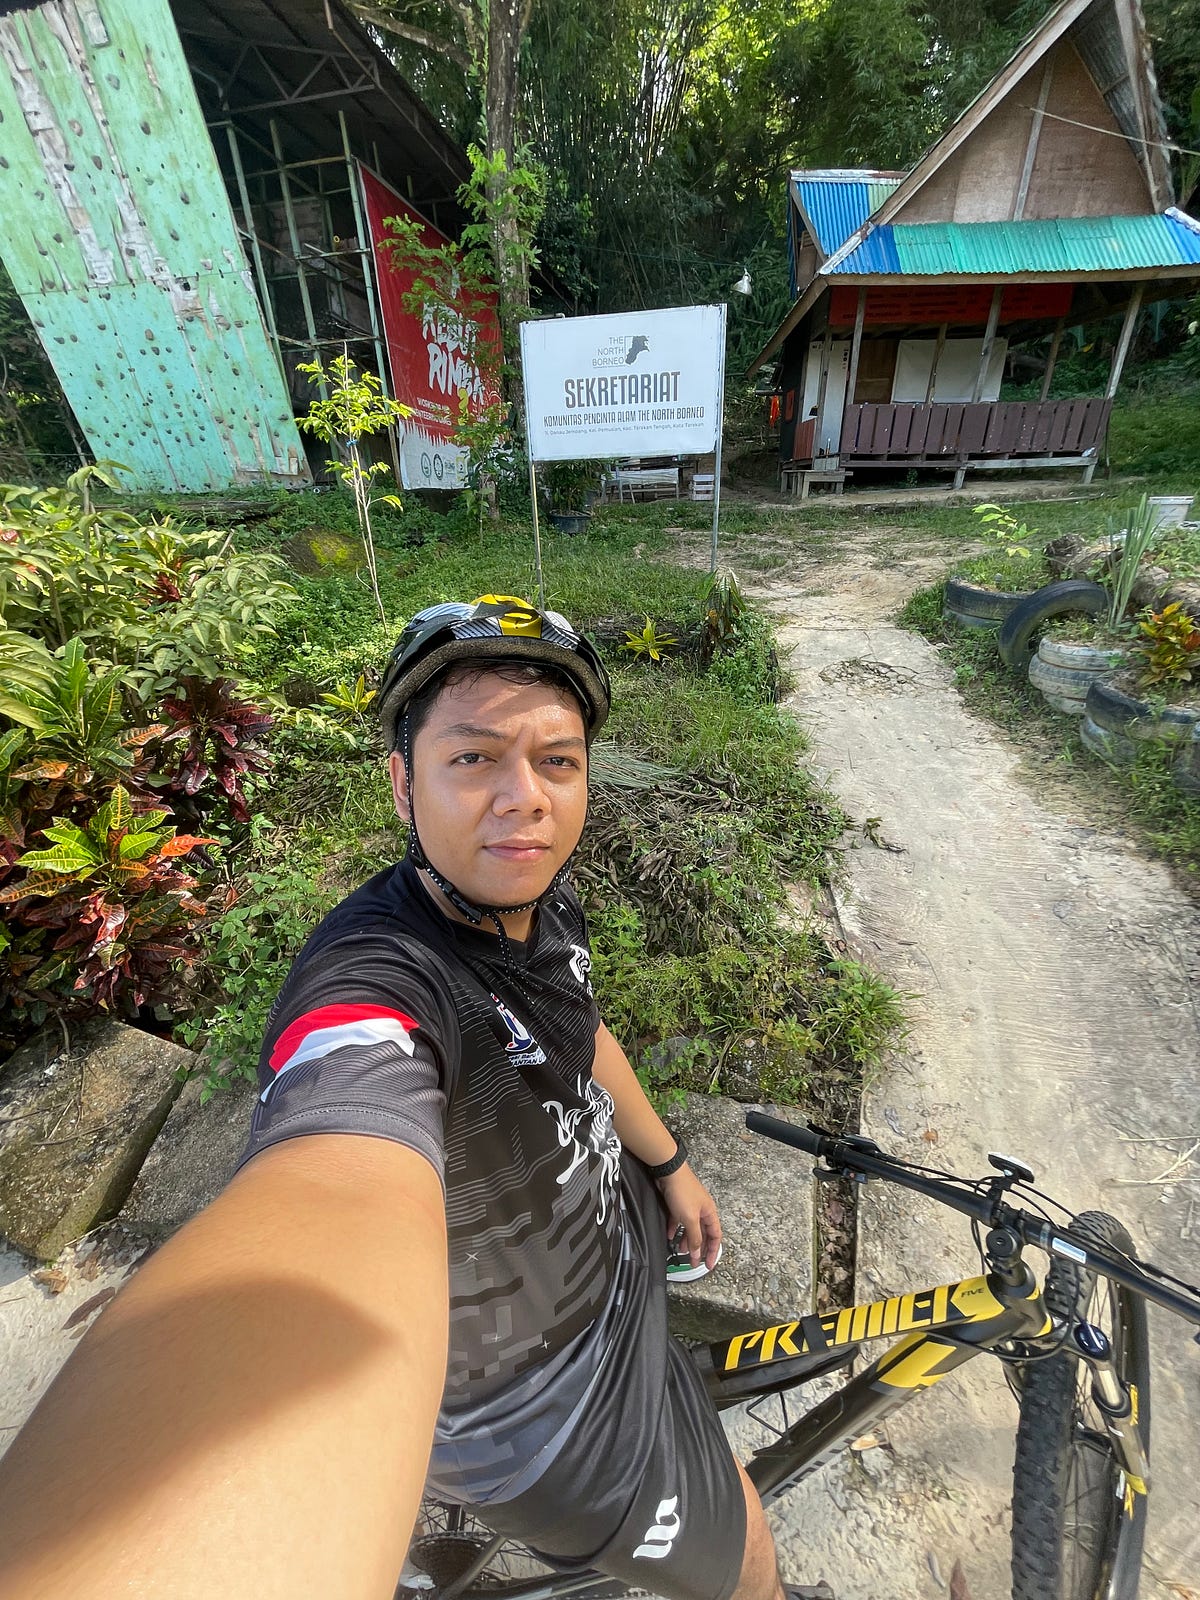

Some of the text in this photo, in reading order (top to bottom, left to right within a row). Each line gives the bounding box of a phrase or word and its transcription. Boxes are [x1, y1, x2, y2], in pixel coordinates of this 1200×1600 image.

[609, 336, 624, 345] THE
[597, 347, 624, 356] NORTH
[592, 356, 625, 366] BORNEO
[564, 371, 681, 408] SEKRETARIAT
[543, 406, 705, 427] KOMUNITAS PENCINTA ALAM THE NORTH BORNEO
[960, 1286, 985, 1298] FIVE
